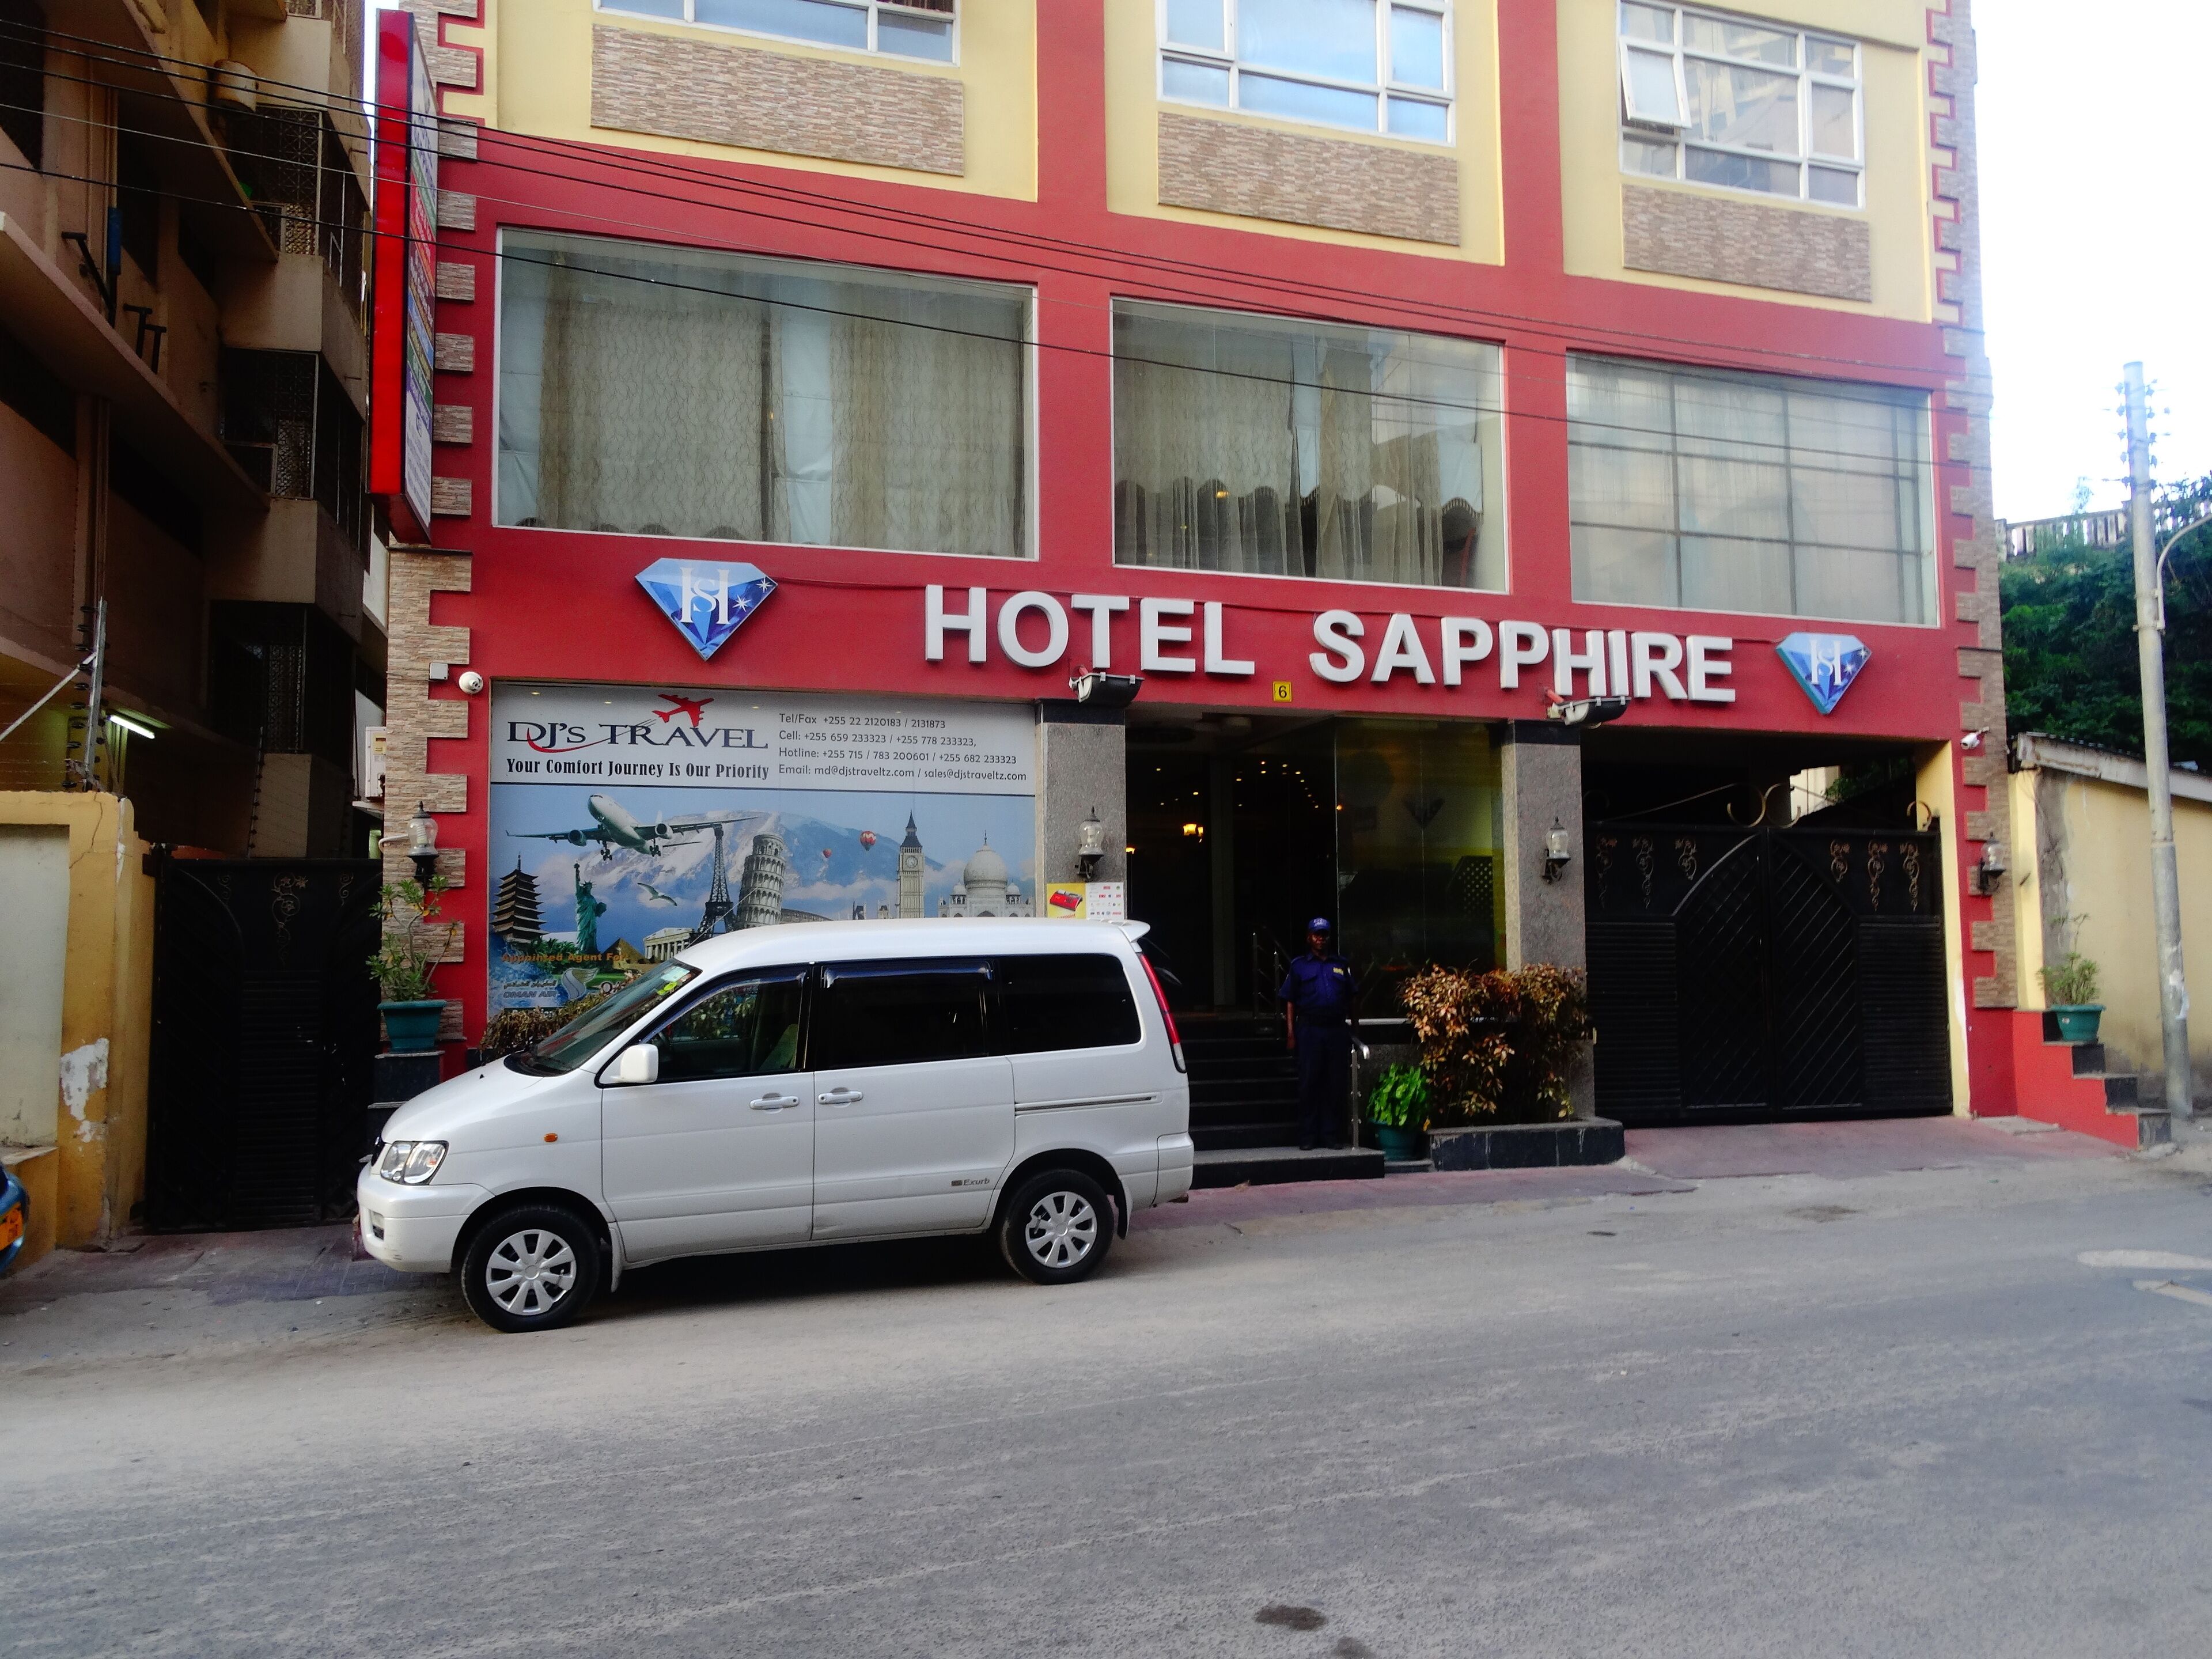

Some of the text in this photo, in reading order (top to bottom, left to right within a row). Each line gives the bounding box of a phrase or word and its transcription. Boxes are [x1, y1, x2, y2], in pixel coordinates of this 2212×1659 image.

[925, 584, 1735, 703] HOTEL SAPPHIRE
[1278, 685, 1287, 698] 6
[779, 713, 817, 724] Tel/Fax
[823, 716, 846, 725] +255
[850, 717, 861, 725] 22
[865, 717, 901, 727] 2120183
[911, 719, 945, 729] 2131873
[599, 724, 768, 749] TRAVEL
[779, 730, 801, 740] Cell:
[804, 732, 827, 741] +255
[831, 733, 848, 742] 659
[852, 734, 886, 743] 233323
[896, 735, 918, 744] +255
[922, 736, 937, 745] 778
[941, 737, 976, 747] 233323,
[779, 747, 819, 758] Hotline:
[823, 749, 845, 759] +255
[849, 750, 863, 759] 715
[873, 751, 889, 760] 783
[893, 752, 929, 761] 200601
[939, 753, 960, 762] +255
[964, 754, 980, 763] 682
[984, 755, 1017, 764] 233323
[506, 758, 769, 780] Your Comfort Journey Is Our Priority
[779, 764, 810, 775] Email:
[815, 765, 914, 777] md@djstraveltz.com
[925, 768, 1027, 781] sales@djstraveltz.com
[501, 953, 563, 964] Appointed
[568, 953, 602, 963] Agent
[963, 1177, 990, 1186] Exurb
